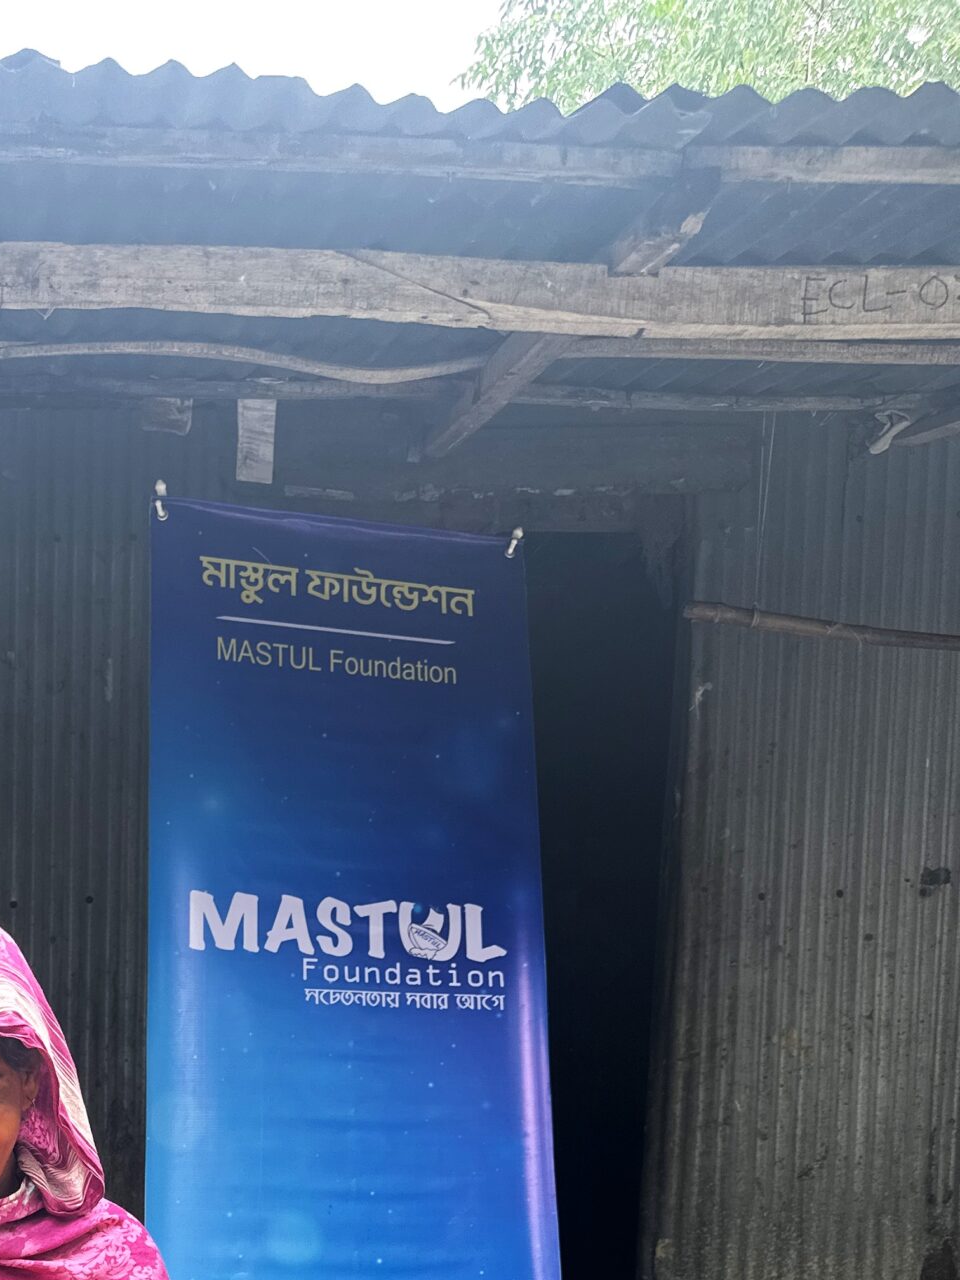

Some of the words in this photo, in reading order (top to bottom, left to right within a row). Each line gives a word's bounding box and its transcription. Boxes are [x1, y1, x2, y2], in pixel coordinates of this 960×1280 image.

[200, 556, 299, 605] মাস্তুল
[305, 567, 475, 617] ফাউন্ডেশন
[216, 636, 322, 672] MASTUL
[330, 650, 457, 684] Foundation
[189, 889, 507, 962] MASTUL
[302, 957, 505, 988] Foundation
[405, 992, 449, 1010] সবার
[455, 993, 505, 1011] আগে
